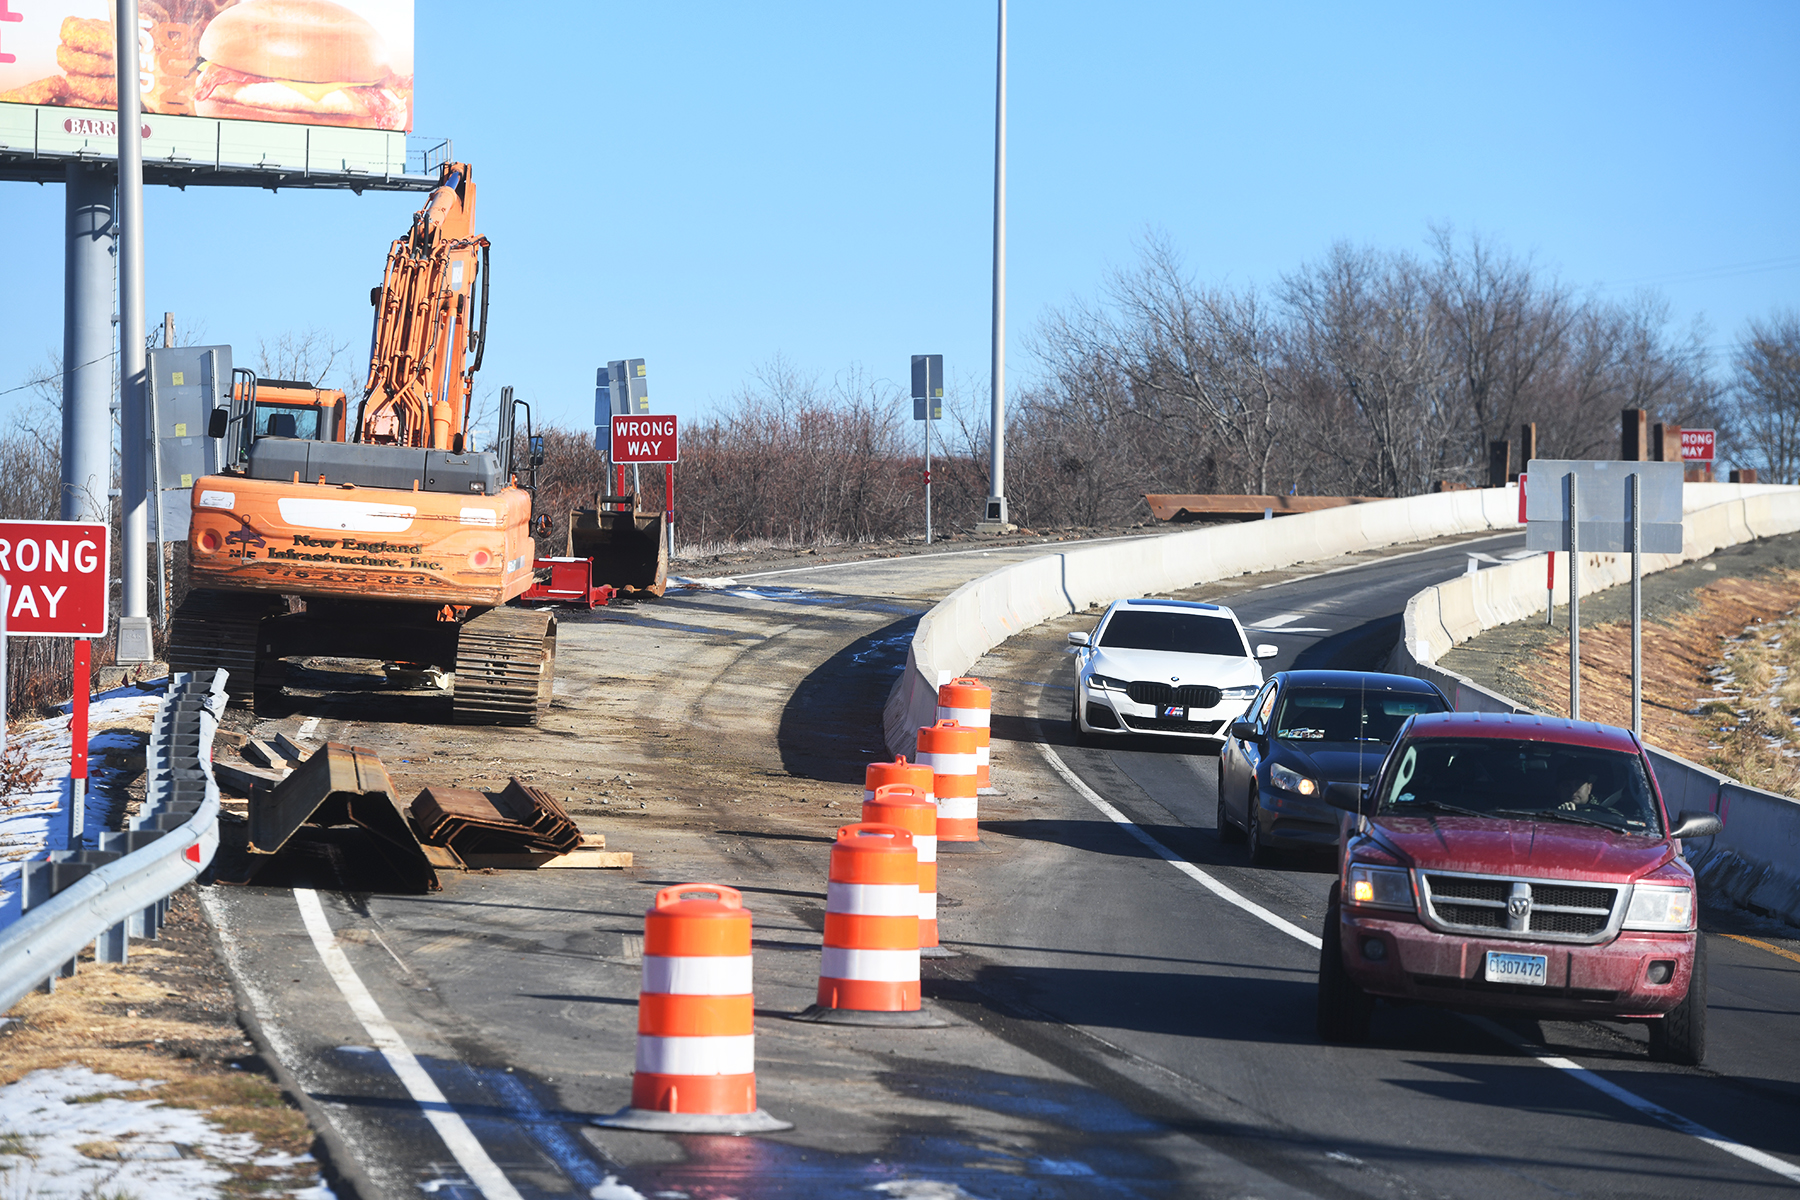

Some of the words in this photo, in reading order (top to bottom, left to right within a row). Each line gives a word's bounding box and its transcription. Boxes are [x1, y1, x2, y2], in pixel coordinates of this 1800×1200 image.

[616, 421, 674, 437] WRONG
[627, 440, 662, 456] WAY
[1682, 433, 1713, 445] RONG
[293, 535, 337, 548] New
[341, 538, 423, 554] England
[0, 538, 98, 573] RONG
[268, 547, 404, 569] Infrastructure,
[5, 584, 68, 618] AY
